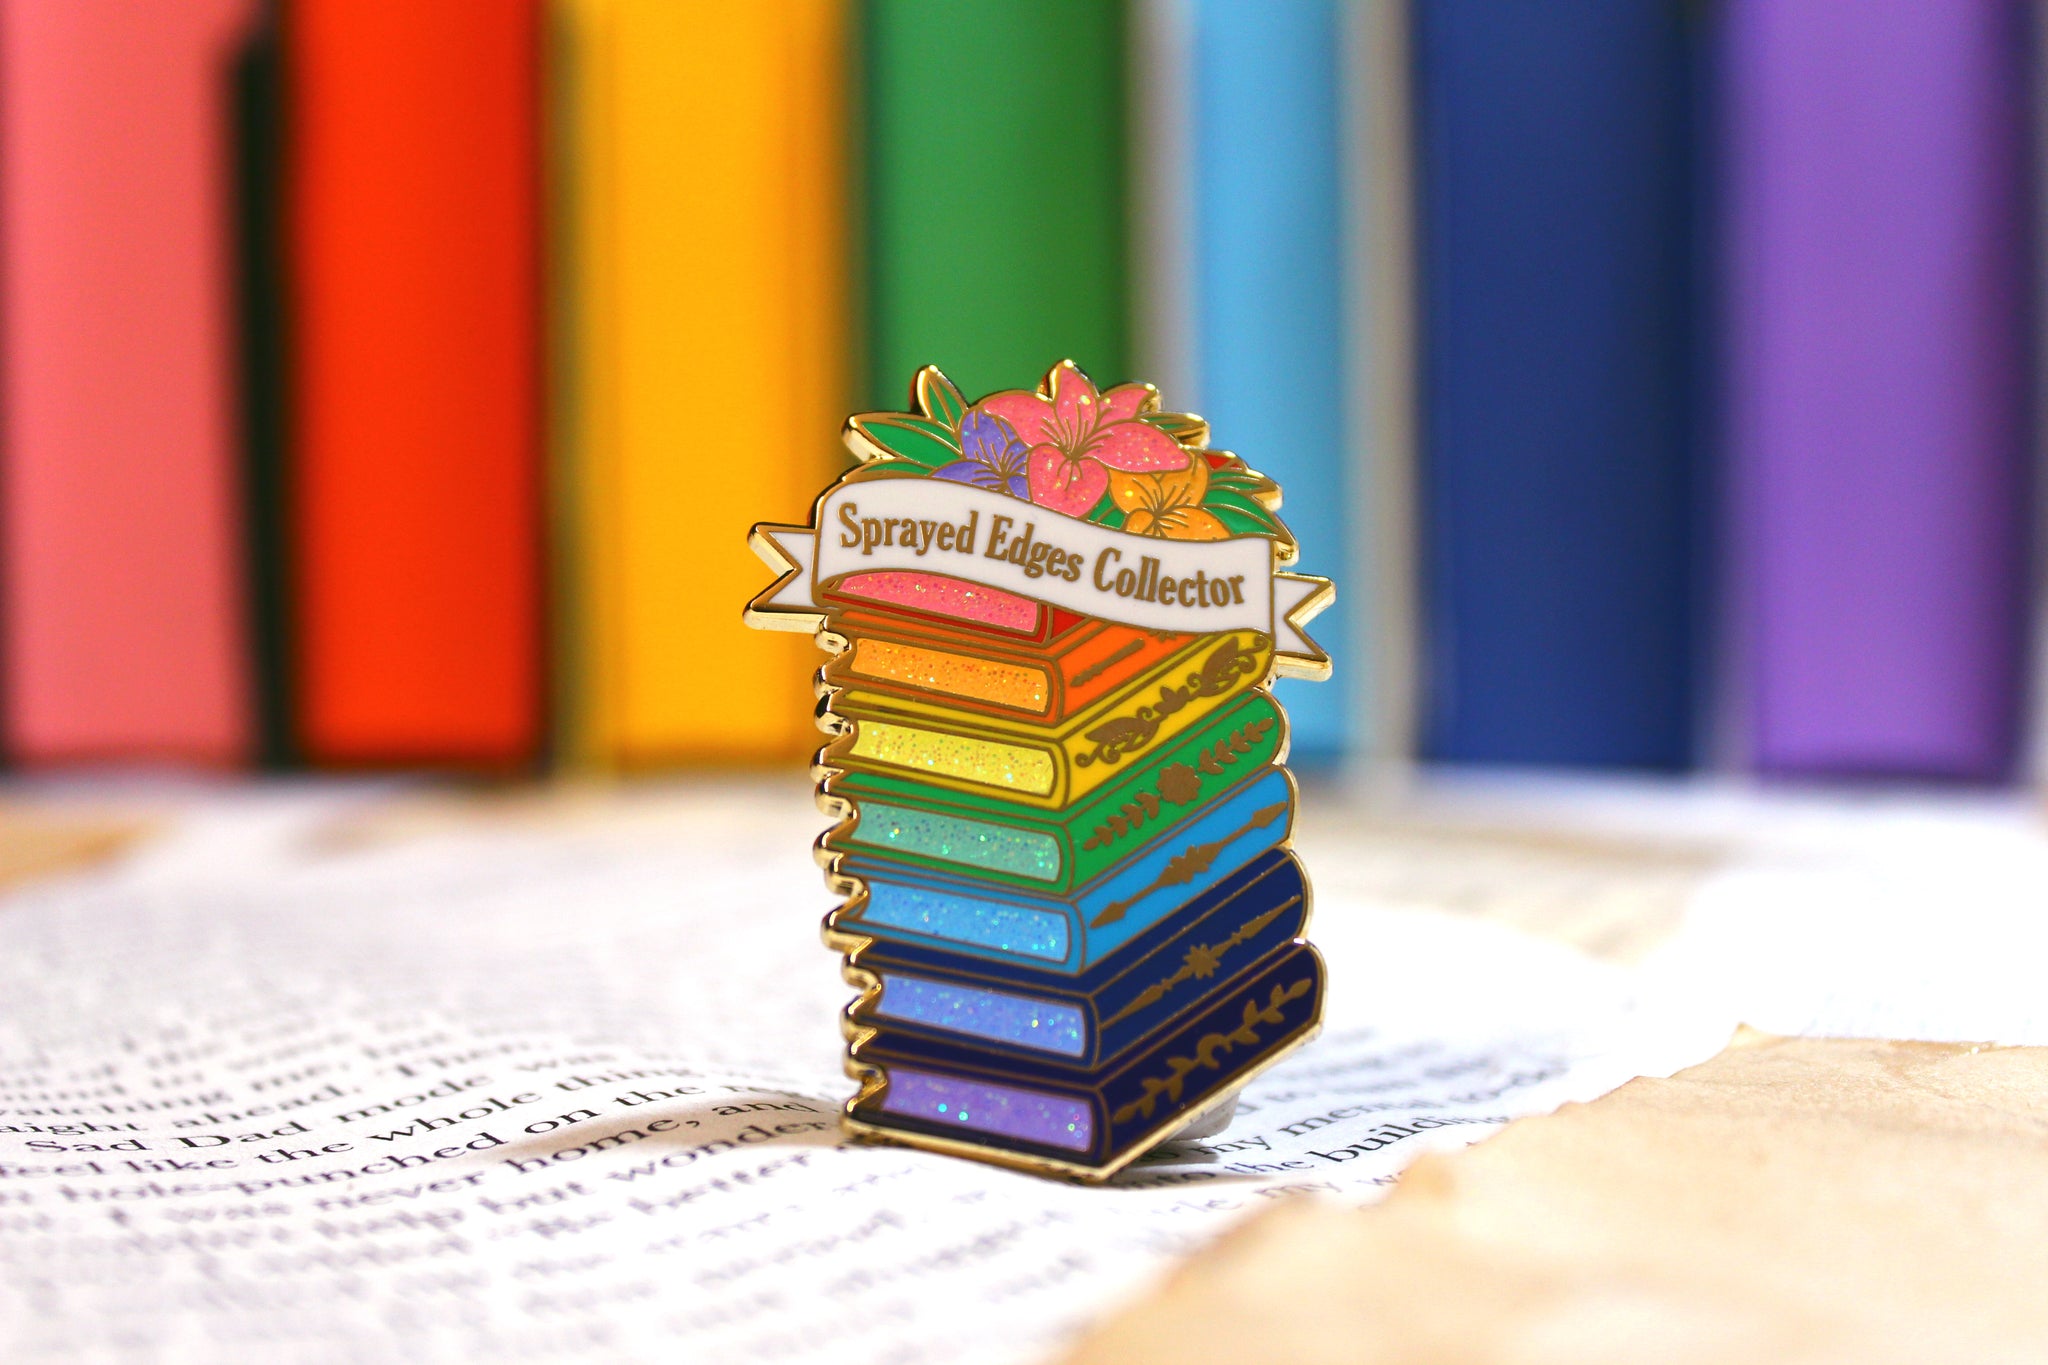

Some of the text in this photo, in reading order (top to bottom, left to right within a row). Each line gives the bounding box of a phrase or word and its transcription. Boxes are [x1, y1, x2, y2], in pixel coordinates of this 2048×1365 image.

[838, 501, 1245, 609] Sprayed Edges Collector
[25, 1139, 152, 1153] Sad
[170, 1121, 313, 1149] Dad
[333, 1075, 494, 1124] mode
[120, 1158, 240, 1174] like
[254, 1148, 354, 1164] the
[366, 1092, 544, 1142] whole
[172, 1083, 362, 1129] ahead.
[523, 1107, 602, 1136] on
[612, 1084, 706, 1107] the
[313, 1170, 487, 1210] never
[499, 1117, 701, 1174] home,
[711, 1100, 822, 1117] and
[605, 1121, 830, 1183] wonder
[1190, 1135, 1273, 1156] my
[1224, 1159, 1315, 1177] the
